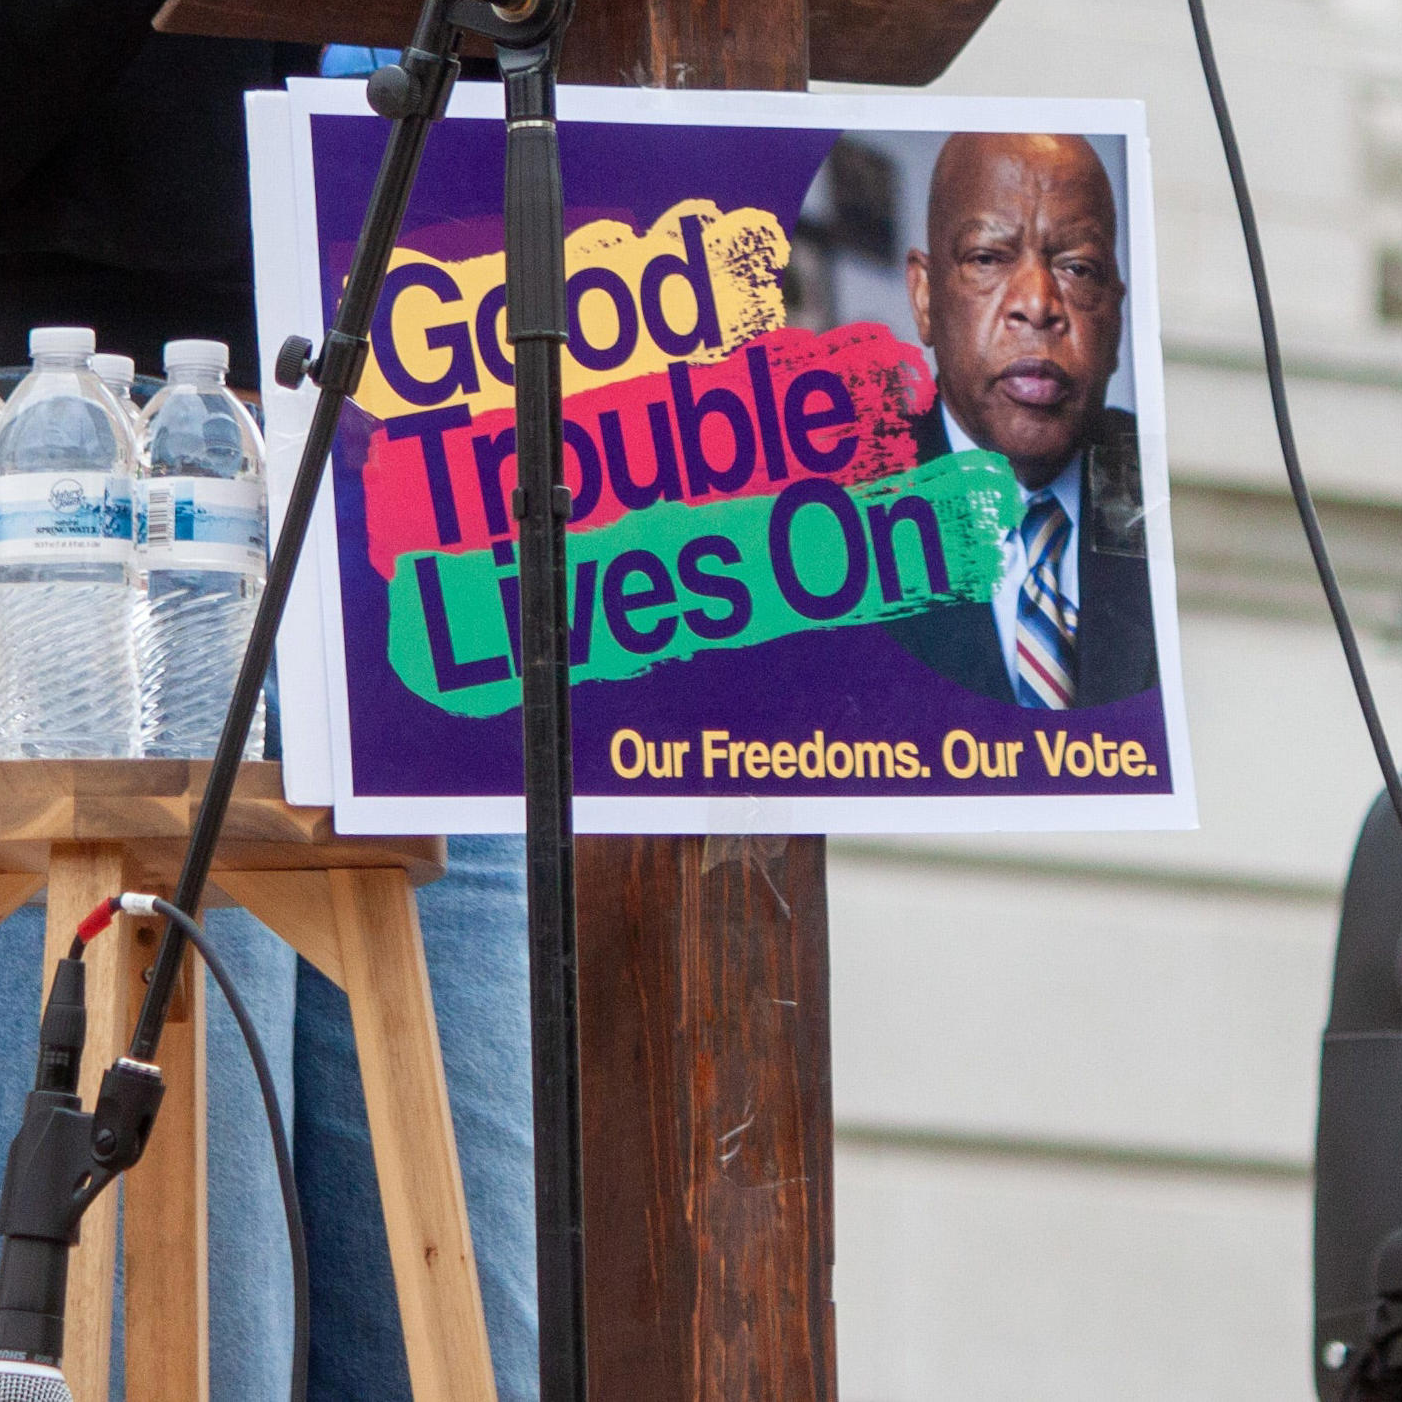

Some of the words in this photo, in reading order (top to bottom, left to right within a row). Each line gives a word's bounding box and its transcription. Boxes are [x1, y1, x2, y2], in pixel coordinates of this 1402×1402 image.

[768, 477, 951, 621] On
[610, 728, 690, 780] Our
[701, 729, 931, 780] Freedoms.
[942, 728, 1024, 779] Our
[1034, 730, 1158, 778] Vote.
